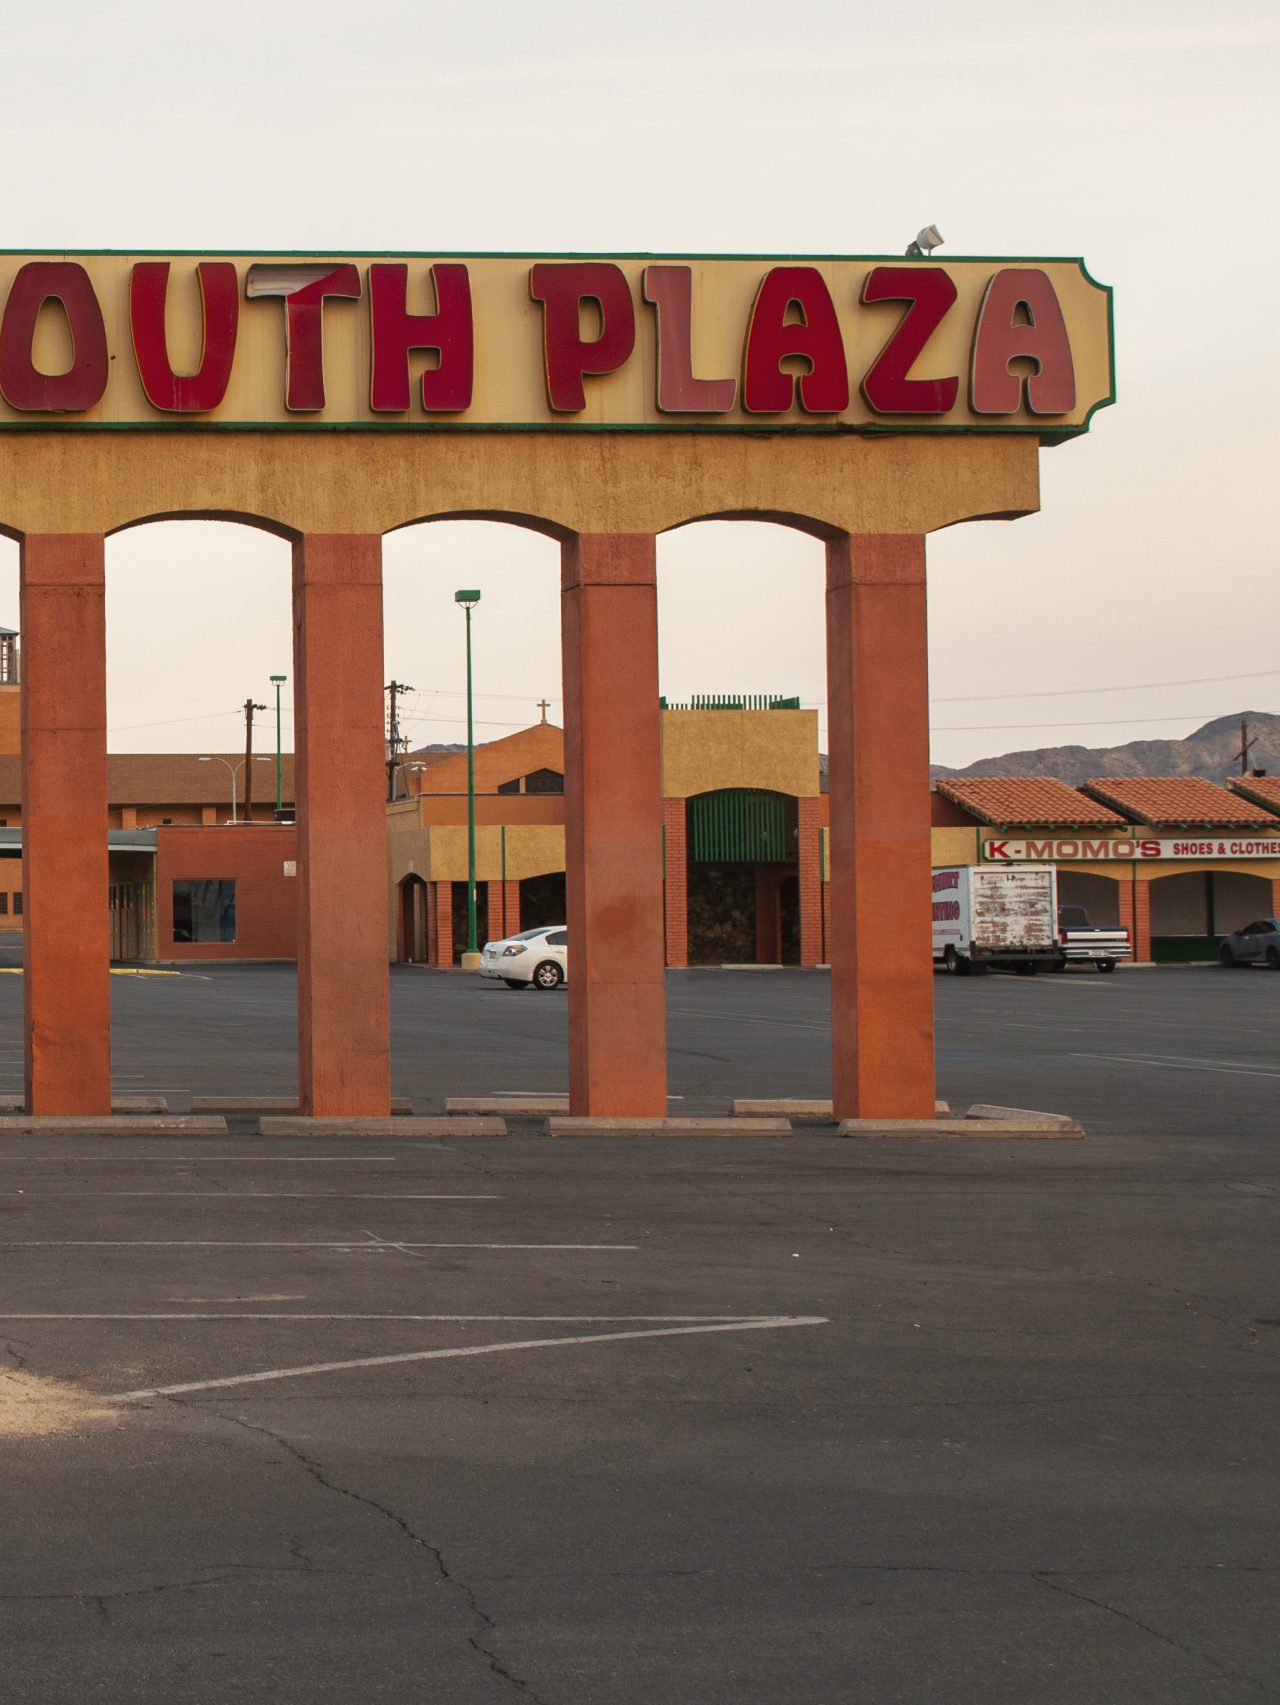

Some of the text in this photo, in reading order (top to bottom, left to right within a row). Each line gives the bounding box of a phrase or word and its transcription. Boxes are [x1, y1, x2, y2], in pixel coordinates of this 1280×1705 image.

[530, 262, 1077, 415] PLAZA
[1173, 842, 1213, 855] SHOES
[1217, 842, 1226, 855] &
